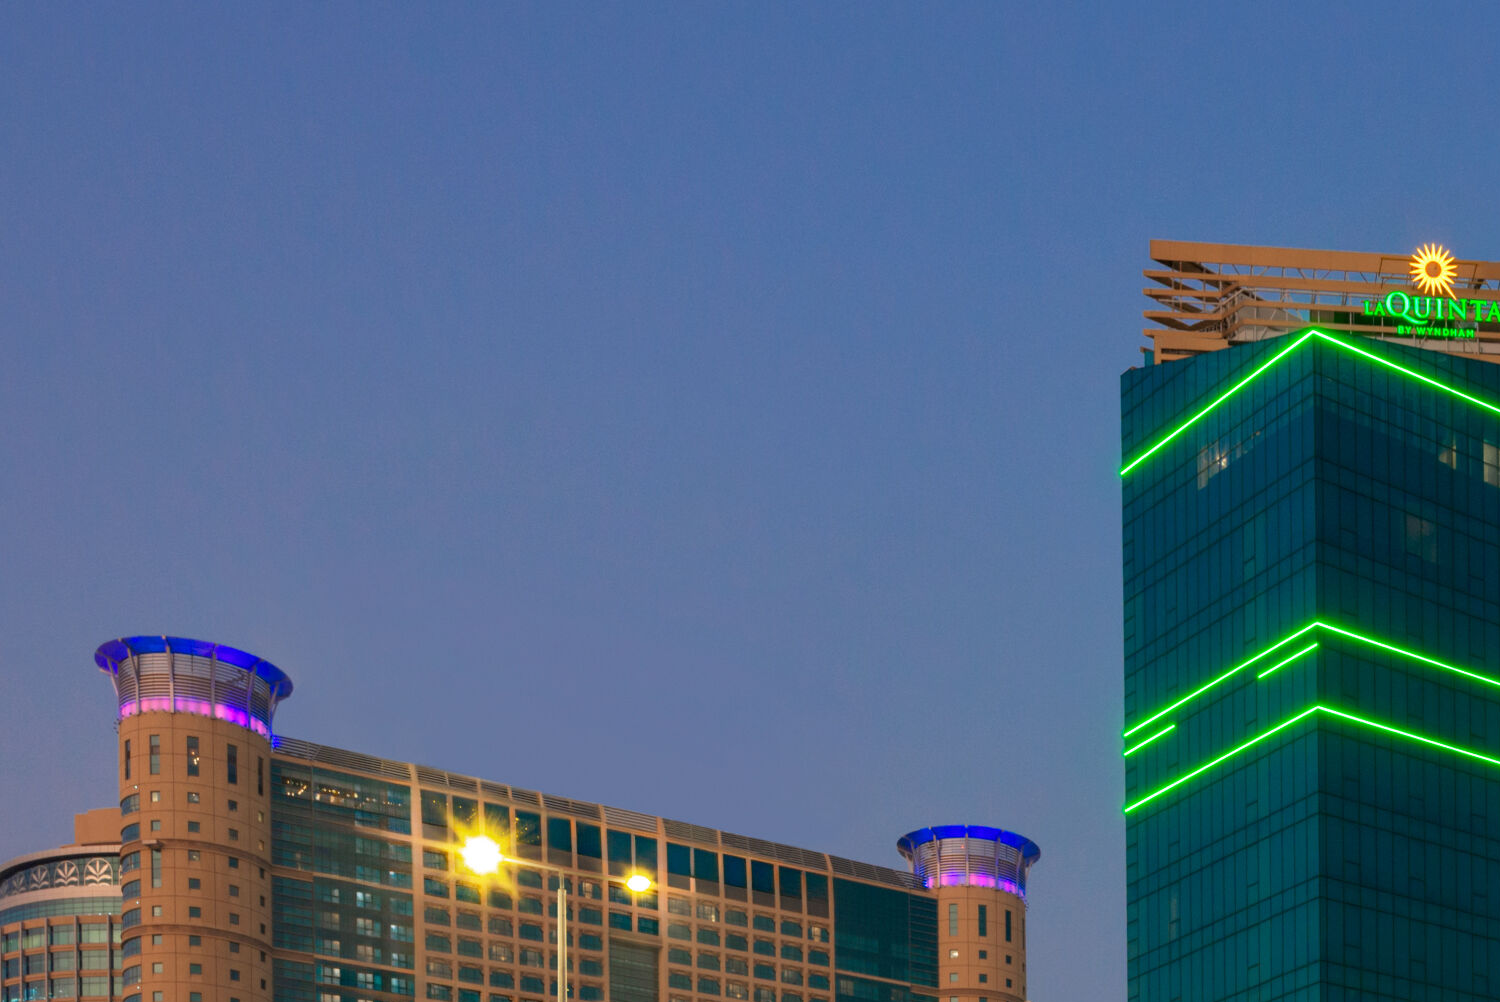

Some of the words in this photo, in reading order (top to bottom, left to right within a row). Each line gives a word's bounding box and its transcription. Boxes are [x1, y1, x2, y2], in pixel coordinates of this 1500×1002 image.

[1364, 300, 1386, 316] LA
[1397, 324, 1412, 335] BY
[1415, 326, 1475, 338] WYNDHAM
